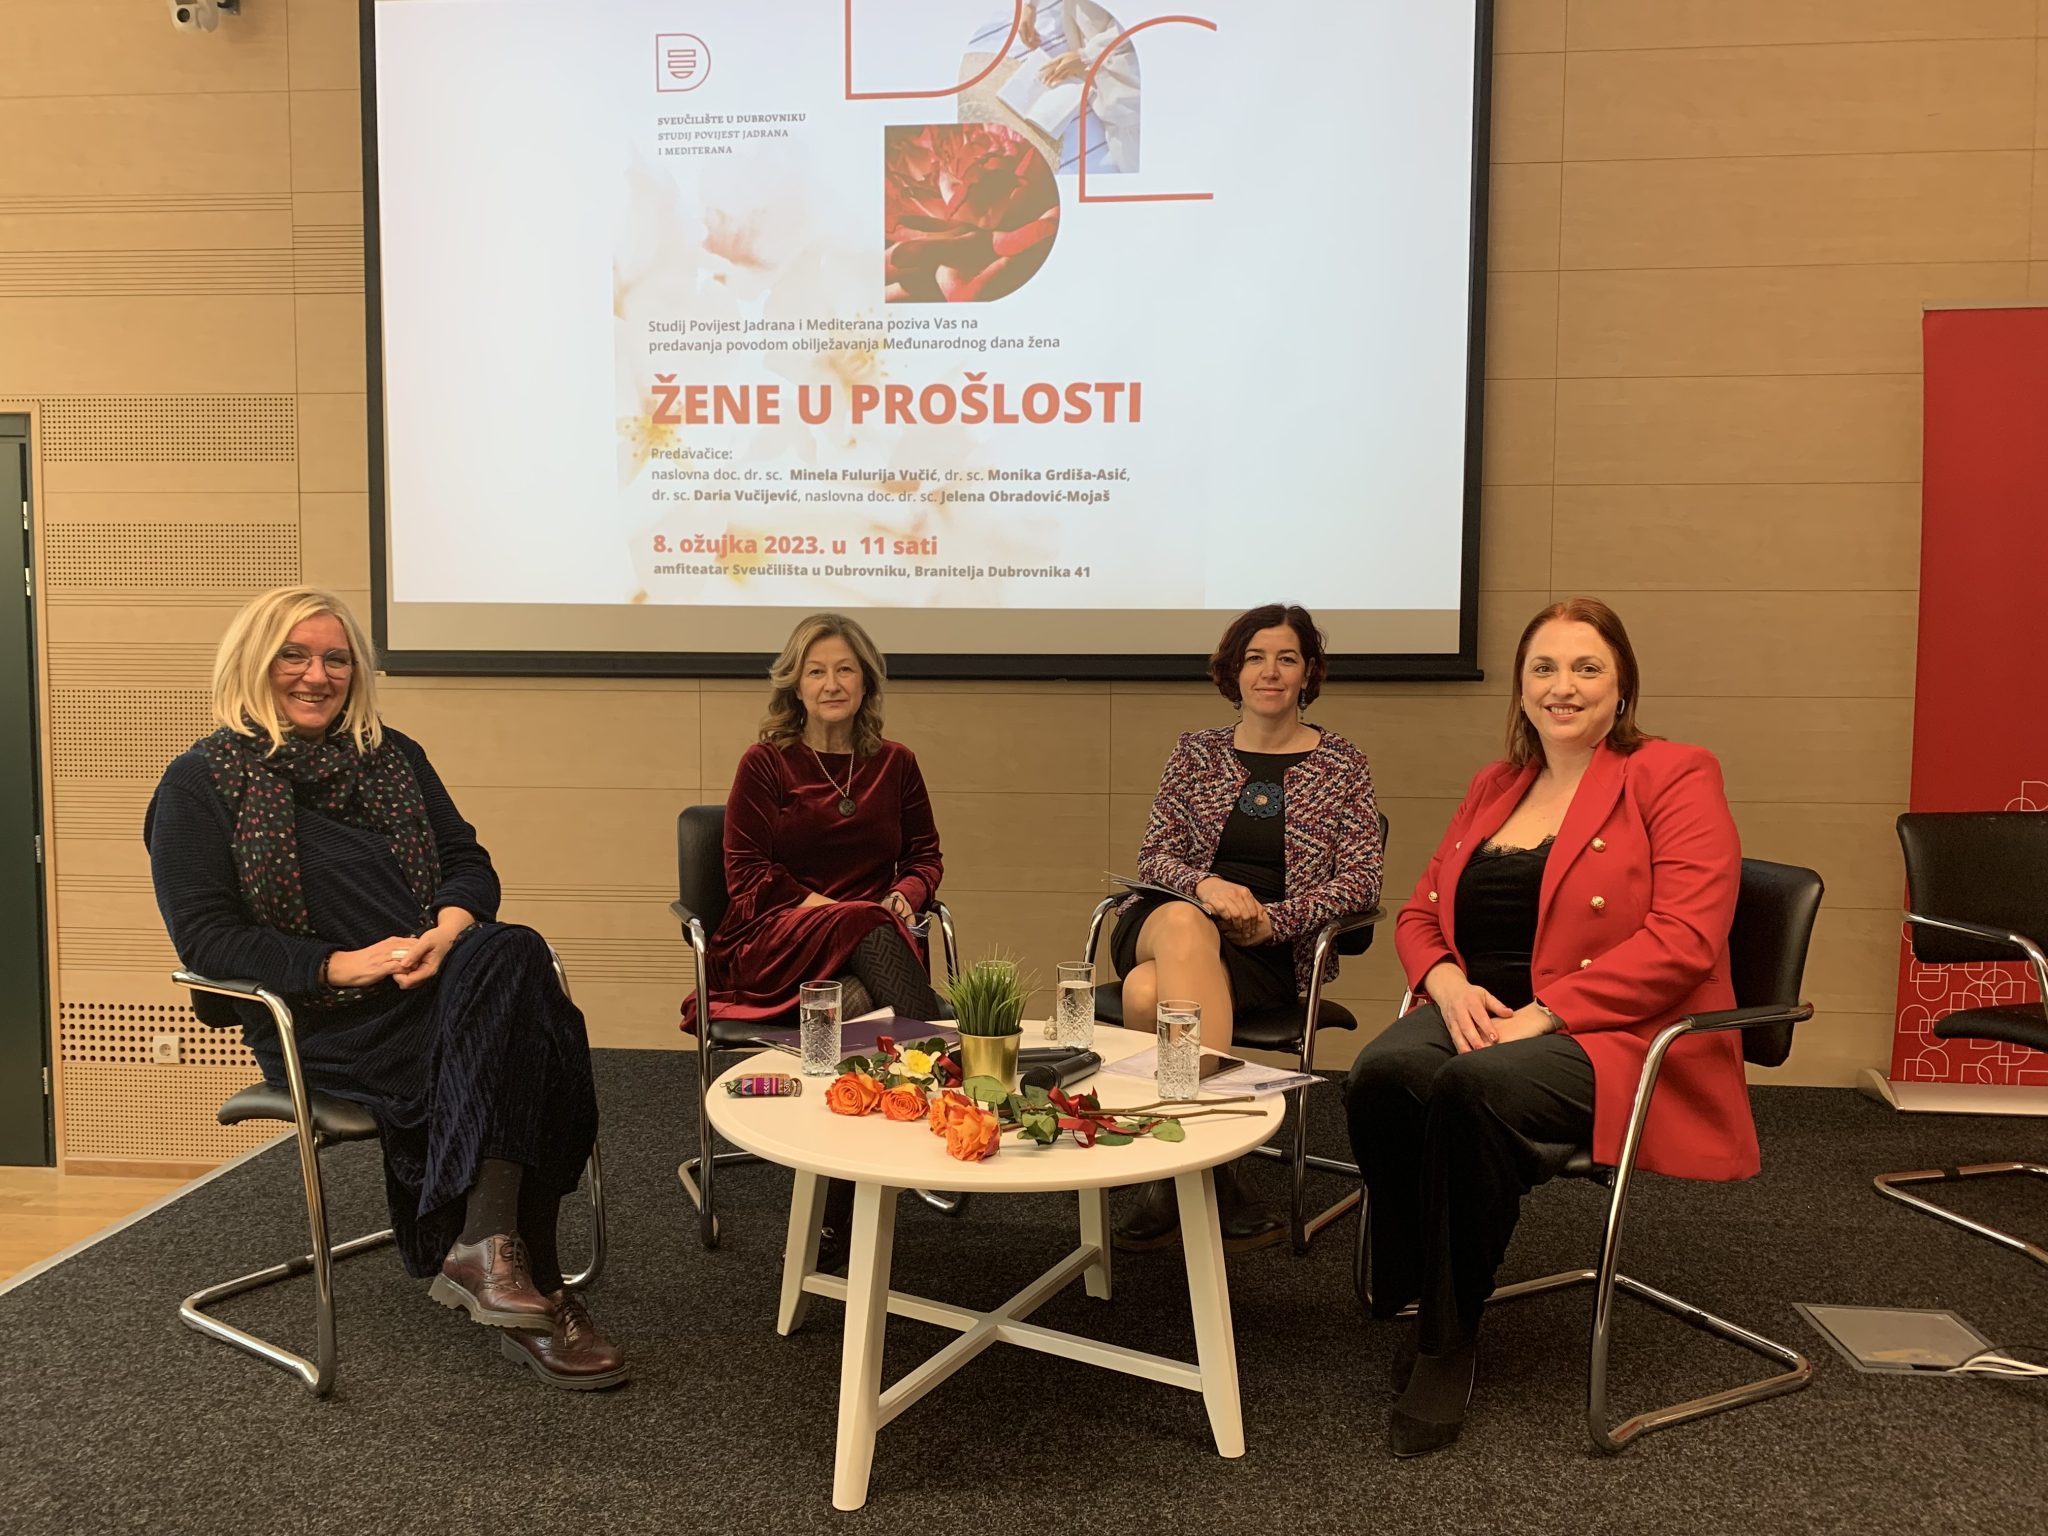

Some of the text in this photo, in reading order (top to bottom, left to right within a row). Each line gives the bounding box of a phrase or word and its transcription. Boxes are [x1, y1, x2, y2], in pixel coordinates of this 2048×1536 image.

[657, 113, 807, 126] SVEUČILIŠTE U DUBROVNIKU
[657, 129, 789, 142] STUDIJ POVIJEST JADRANA
[658, 145, 733, 156] I MEDITERANA
[648, 317, 978, 336] Studij Povijest Jadrana i Mediterana poziva Vas na
[649, 335, 1060, 355] predavanja povodom obilježavanja Međunarodnog dana žena
[651, 371, 1142, 425] ŽENE U PROŠLOSTI
[651, 447, 733, 460] Predavačice:
[651, 468, 1130, 484] naslovna doc. dr. sc. Minela Fulurija Vučić, dr. sc. Monika Grdiša-Asić,
[651, 489, 1110, 505] dr. sc. Daria Vučijević, naslovna doc. dr. sc. Jelena Obradović-Mojaš
[652, 533, 938, 558] 8. ožujka 2023. u 11 sati
[653, 563, 1091, 580] amfiteatar Sveučilišta u Dubrovniku, Branitelja Dubrovnika 41
